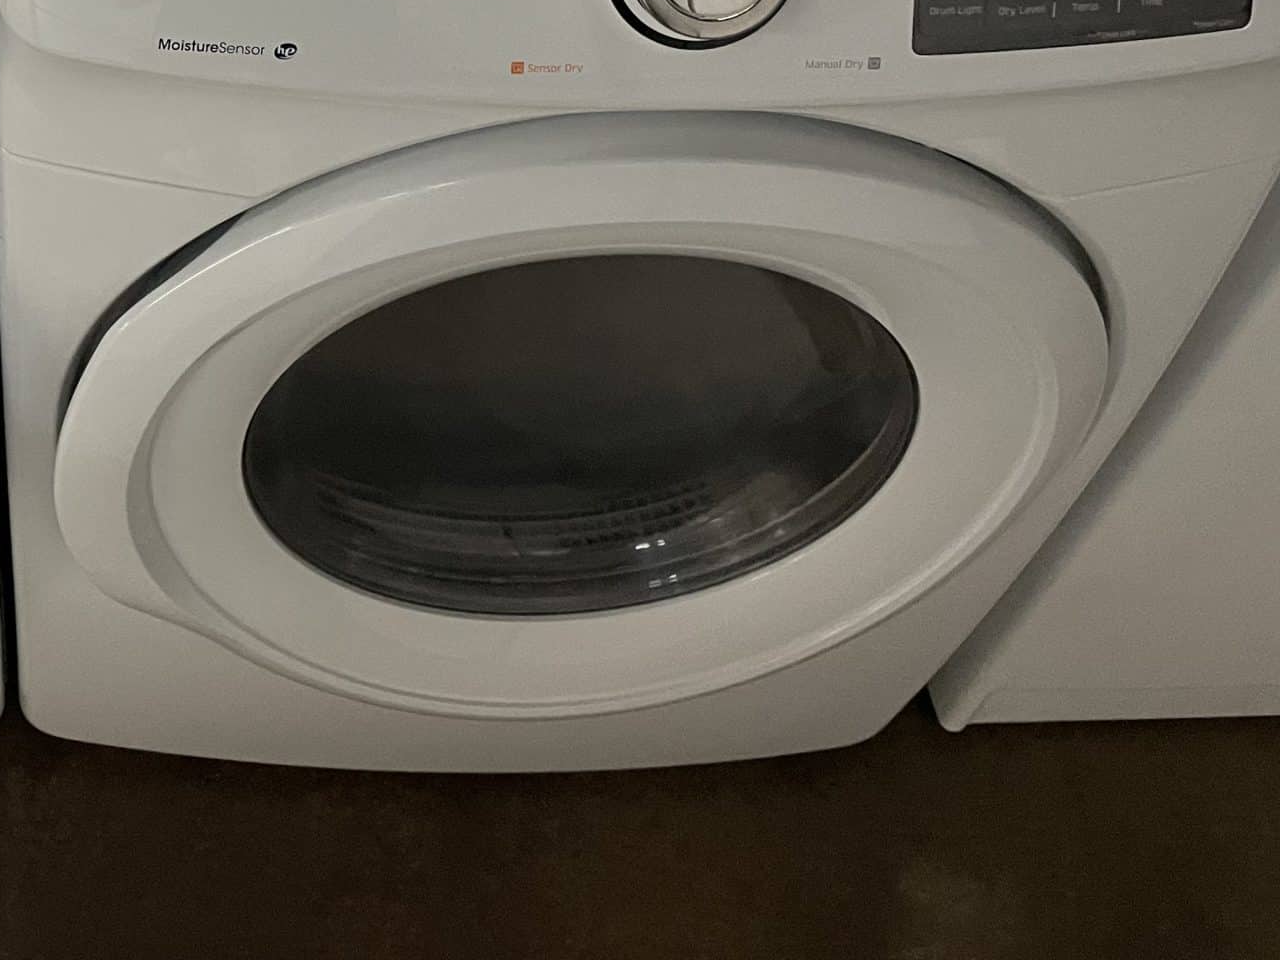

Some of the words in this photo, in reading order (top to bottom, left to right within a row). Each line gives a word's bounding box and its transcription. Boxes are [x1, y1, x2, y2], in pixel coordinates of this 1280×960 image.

[157, 37, 266, 57] MoistureSensor
[527, 62, 562, 74] Sensor
[565, 62, 584, 75] Dry
[805, 59, 843, 70] Manual
[845, 59, 864, 72] Dry
